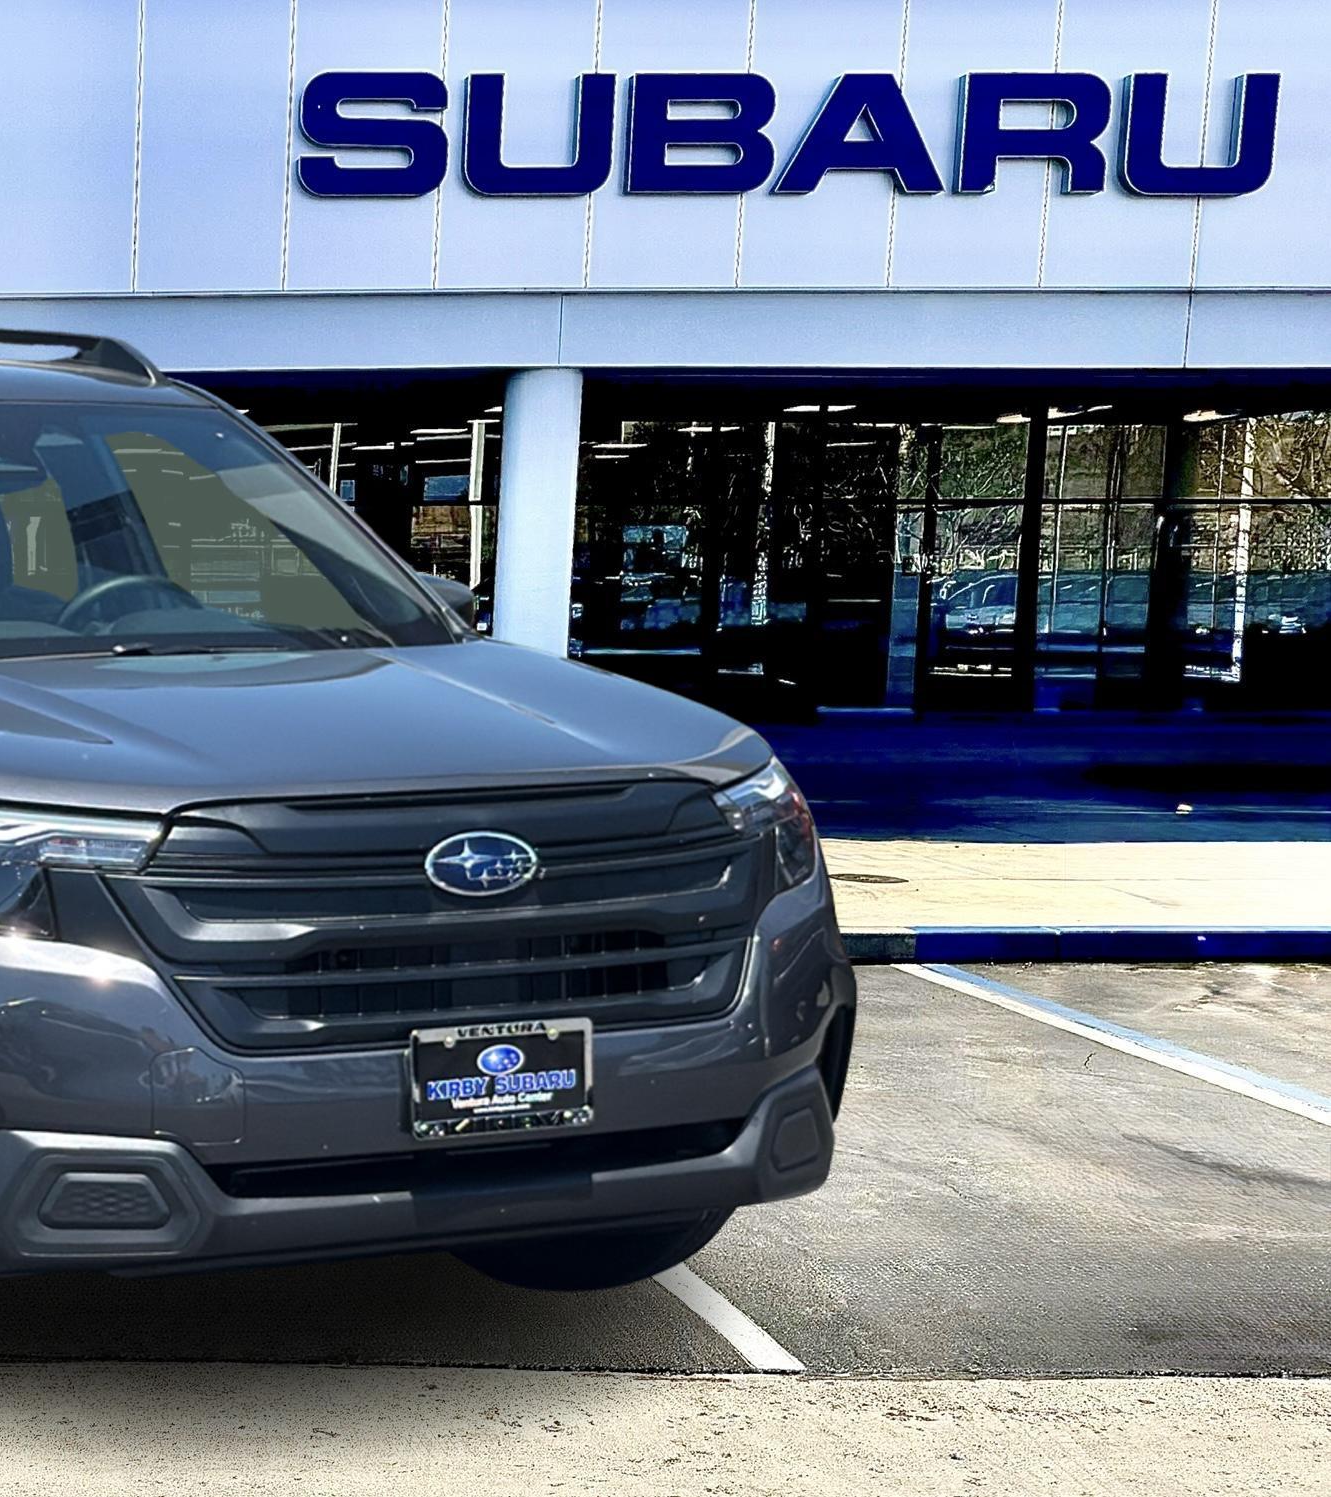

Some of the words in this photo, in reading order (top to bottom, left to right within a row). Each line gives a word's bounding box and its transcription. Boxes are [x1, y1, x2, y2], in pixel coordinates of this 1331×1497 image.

[296, 70, 1282, 198] SUBARU
[456, 1021, 548, 1038] VENTURA
[426, 1076, 490, 1101] KIRBY
[493, 1069, 576, 1095] SUBARU
[491, 1094, 516, 1105] Auto
[517, 1091, 553, 1103] Center
